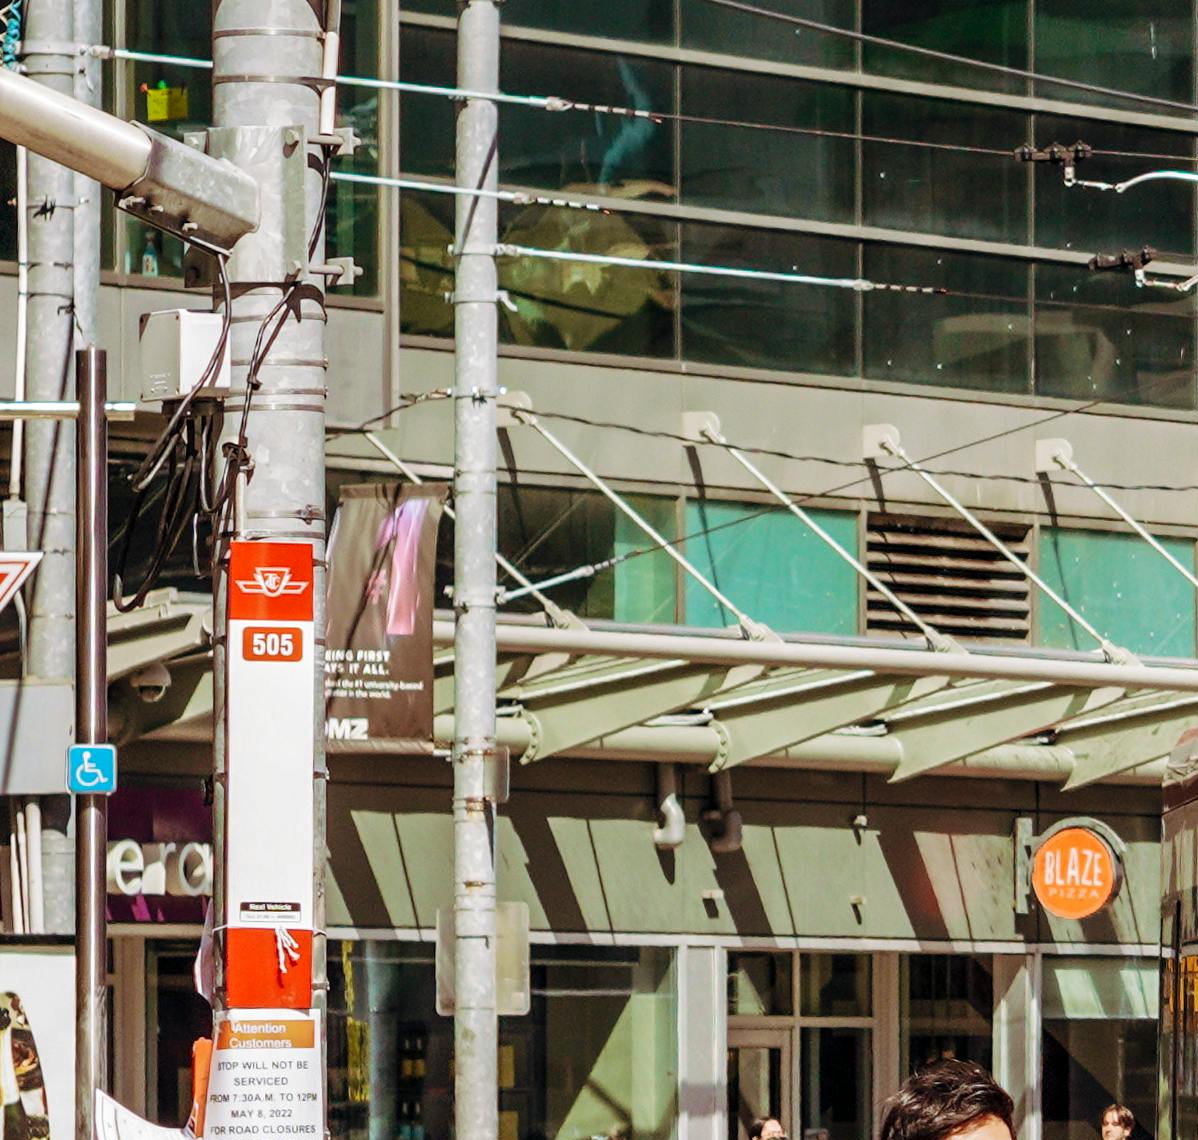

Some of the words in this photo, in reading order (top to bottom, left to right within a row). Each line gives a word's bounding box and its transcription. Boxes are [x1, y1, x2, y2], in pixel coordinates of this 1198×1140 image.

[252, 633, 293, 656] 505
[356, 649, 390, 662] FIRST
[348, 663, 360, 674] IT
[363, 663, 390, 675] ALL.
[1044, 847, 1104, 886] BLAZE
[1047, 887, 1099, 899] PIZZA
[231, 1022, 286, 1034] Attention
[229, 1037, 292, 1049] Customers
[217, 1061, 238, 1071] STOP
[242, 1061, 268, 1070] WILL
[271, 1061, 293, 1070] NOT
[296, 1060, 309, 1069] BE
[233, 1077, 288, 1086] SERVICED
[280, 1093, 293, 1101] TO
[297, 1092, 318, 1101] 12PM
[230, 1109, 253, 1118] MAY
[269, 1108, 293, 1118] 2022
[210, 1126, 226, 1135] FOR
[228, 1125, 259, 1134] ROAD
[262, 1124, 316, 1134] CLOSURES
